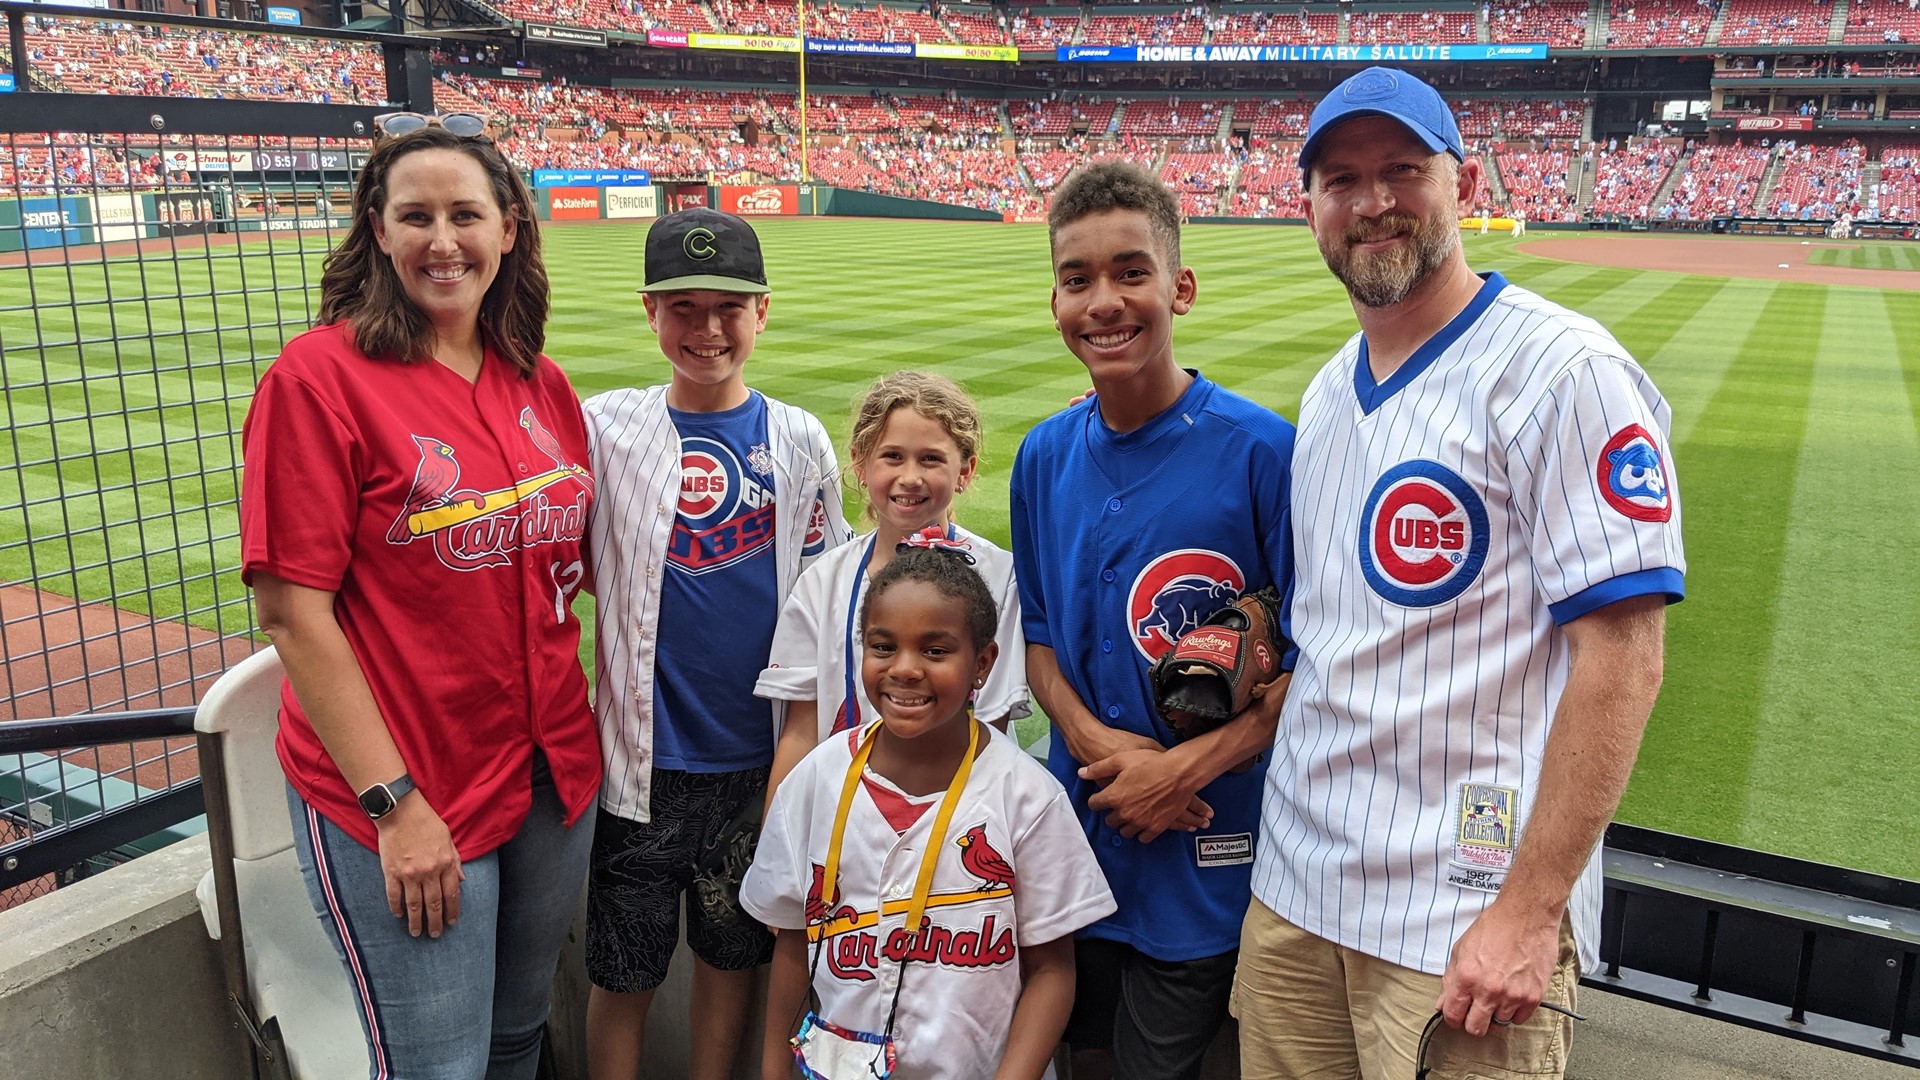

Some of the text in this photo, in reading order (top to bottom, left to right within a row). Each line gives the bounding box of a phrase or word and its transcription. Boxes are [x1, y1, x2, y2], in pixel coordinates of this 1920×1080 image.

[808, 41, 823, 51] Buy
[823, 43, 837, 51] now
[1265, 47, 1360, 61] MILITARY
[1370, 47, 1451, 61] SALUTE
[608, 194, 654, 211] PERFICIENT
[260, 220, 293, 231] BUSCH
[683, 227, 716, 261] C
[1374, 481, 1464, 585] CUBS
[1181, 634, 1232, 652] Rawlings
[1463, 821, 1507, 846] COLLECTION
[1216, 841, 1247, 852] Majestic
[1449, 875, 1501, 890] ANDRE DAWS
[1465, 870, 1493, 882] 1987
